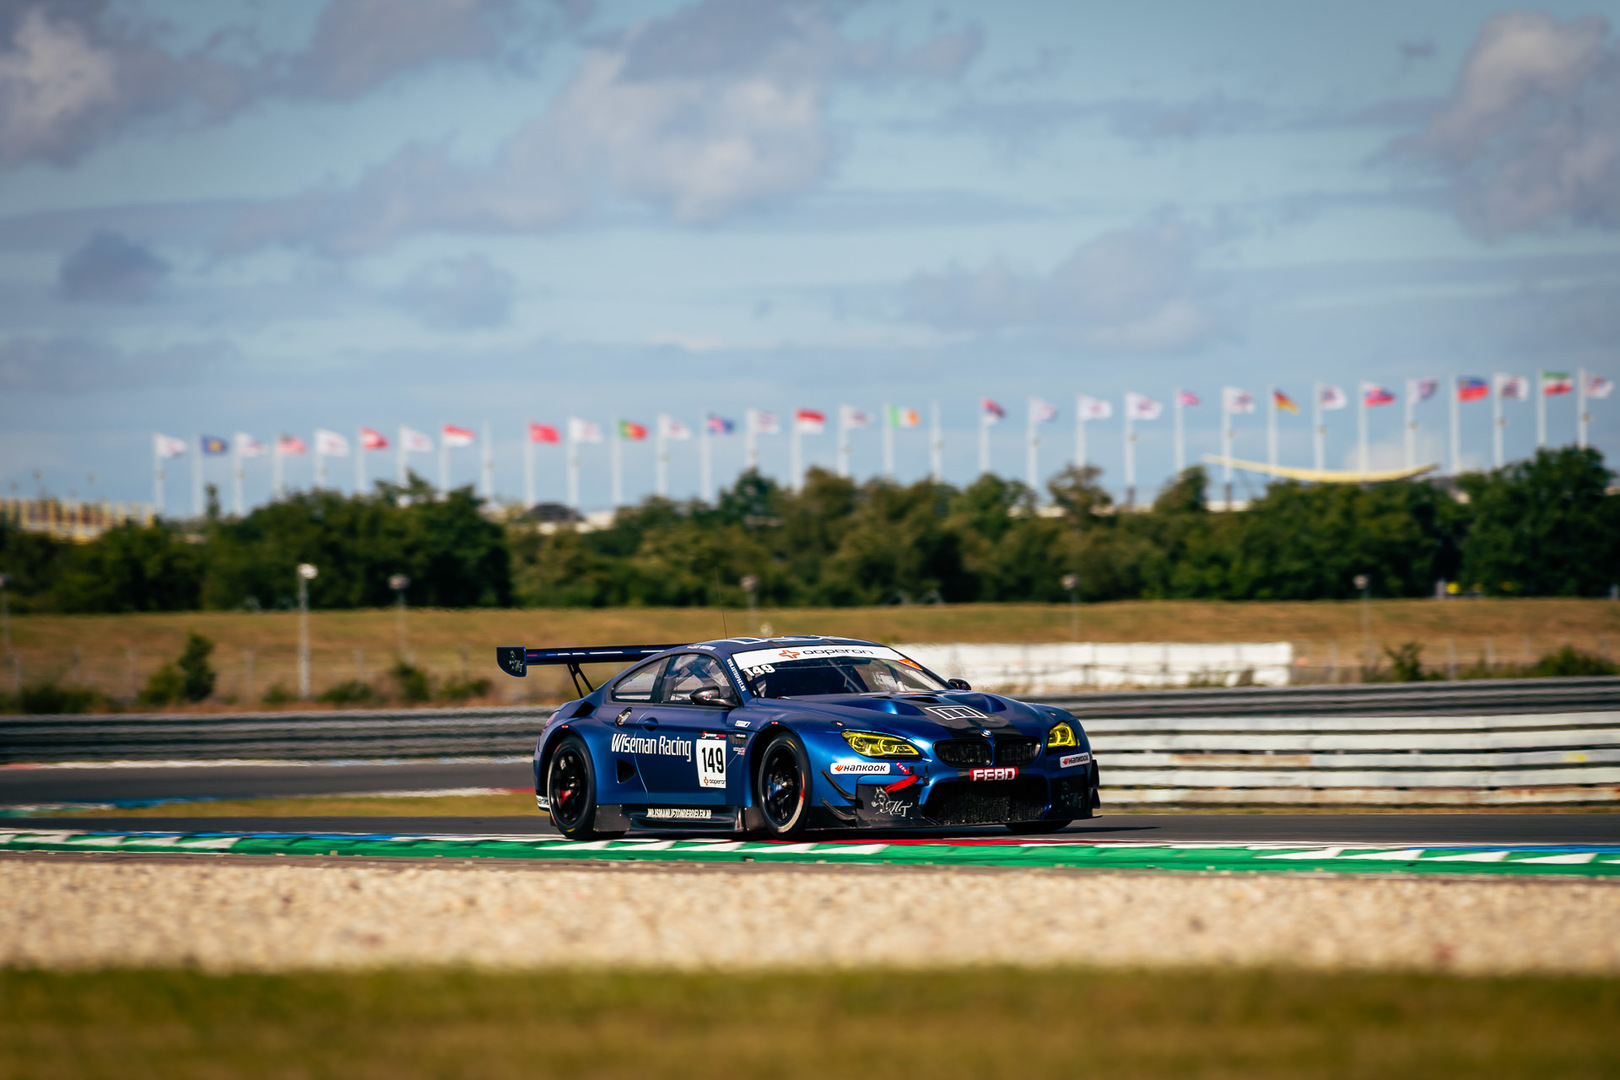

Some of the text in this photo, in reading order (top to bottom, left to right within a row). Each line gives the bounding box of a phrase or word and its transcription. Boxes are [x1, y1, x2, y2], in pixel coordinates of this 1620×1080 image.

[742, 664, 776, 677] 149
[611, 733, 692, 762] Wiseman Racing
[701, 747, 724, 774] 149
[973, 767, 1016, 782] FEBO
